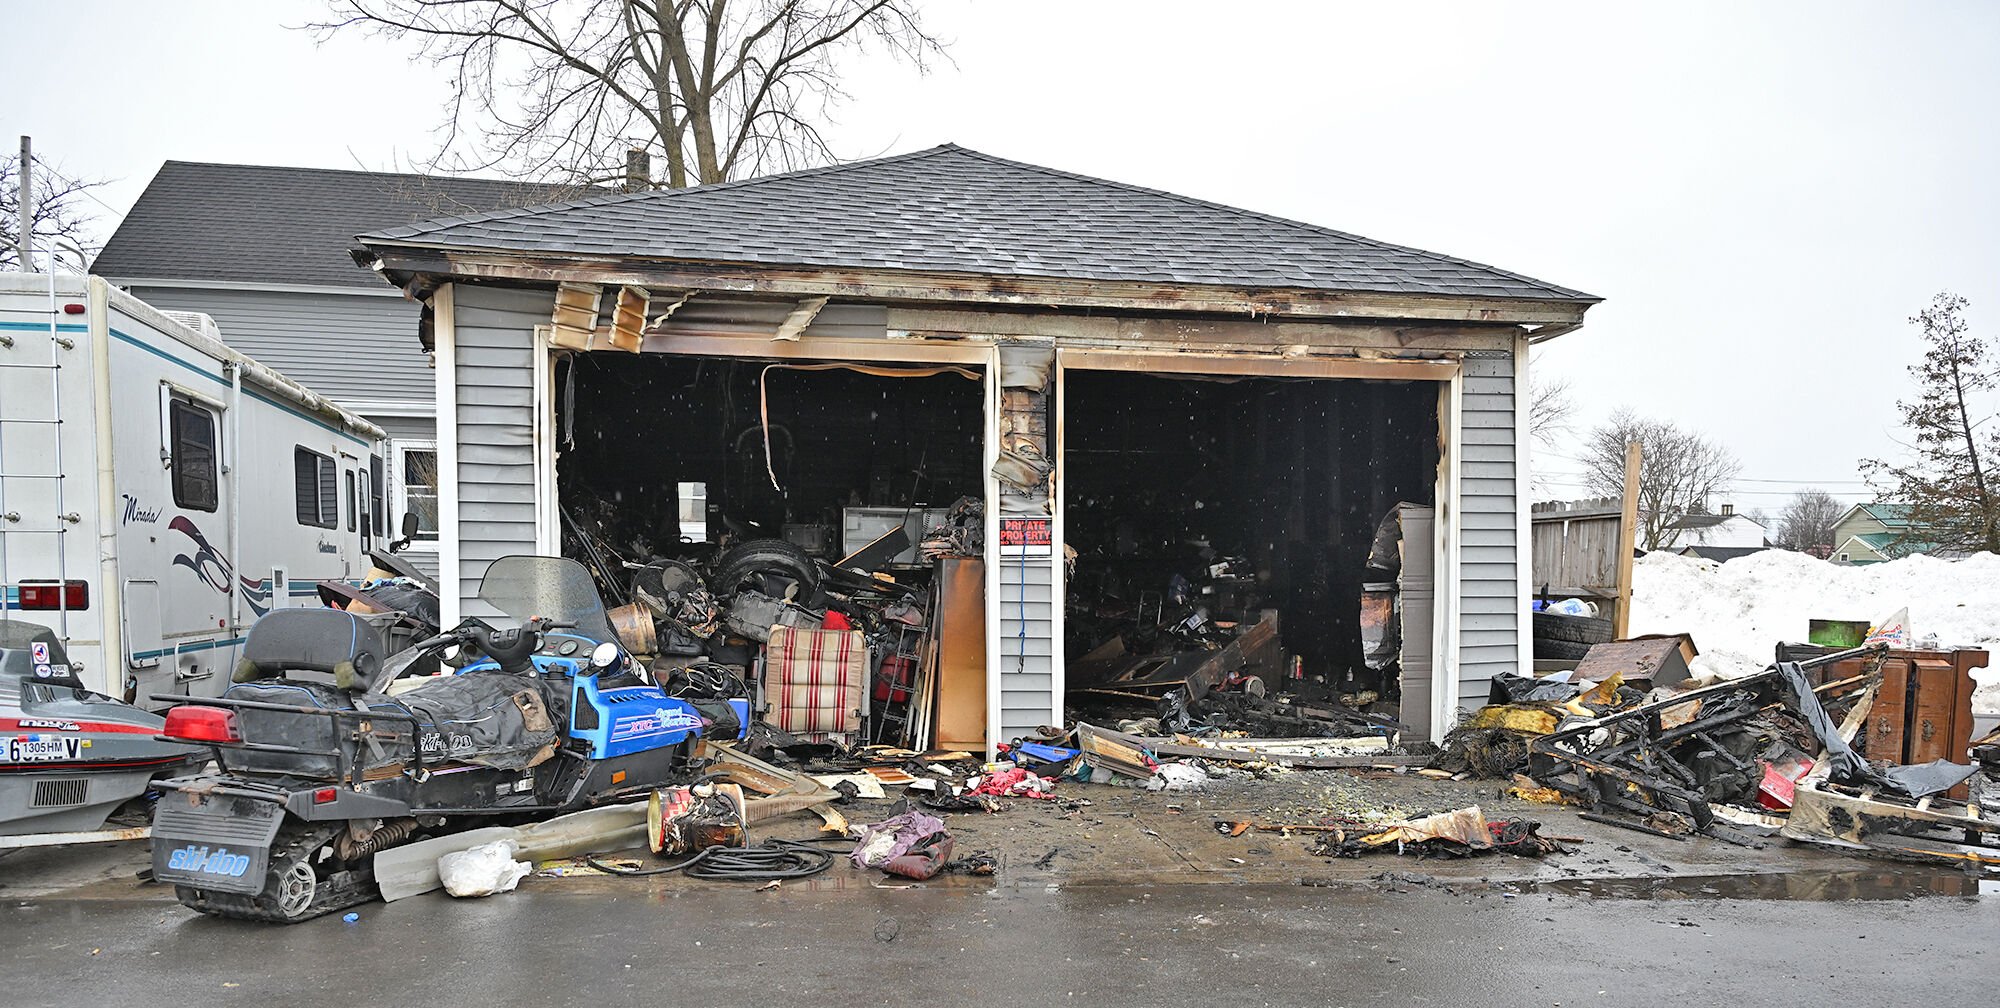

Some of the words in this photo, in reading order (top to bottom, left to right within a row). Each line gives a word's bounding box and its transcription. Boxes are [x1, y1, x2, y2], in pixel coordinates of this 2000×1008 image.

[122, 494, 163, 527] Mirada
[23, 742, 63, 753] 1305HM
[168, 844, 250, 877] ski-doo
